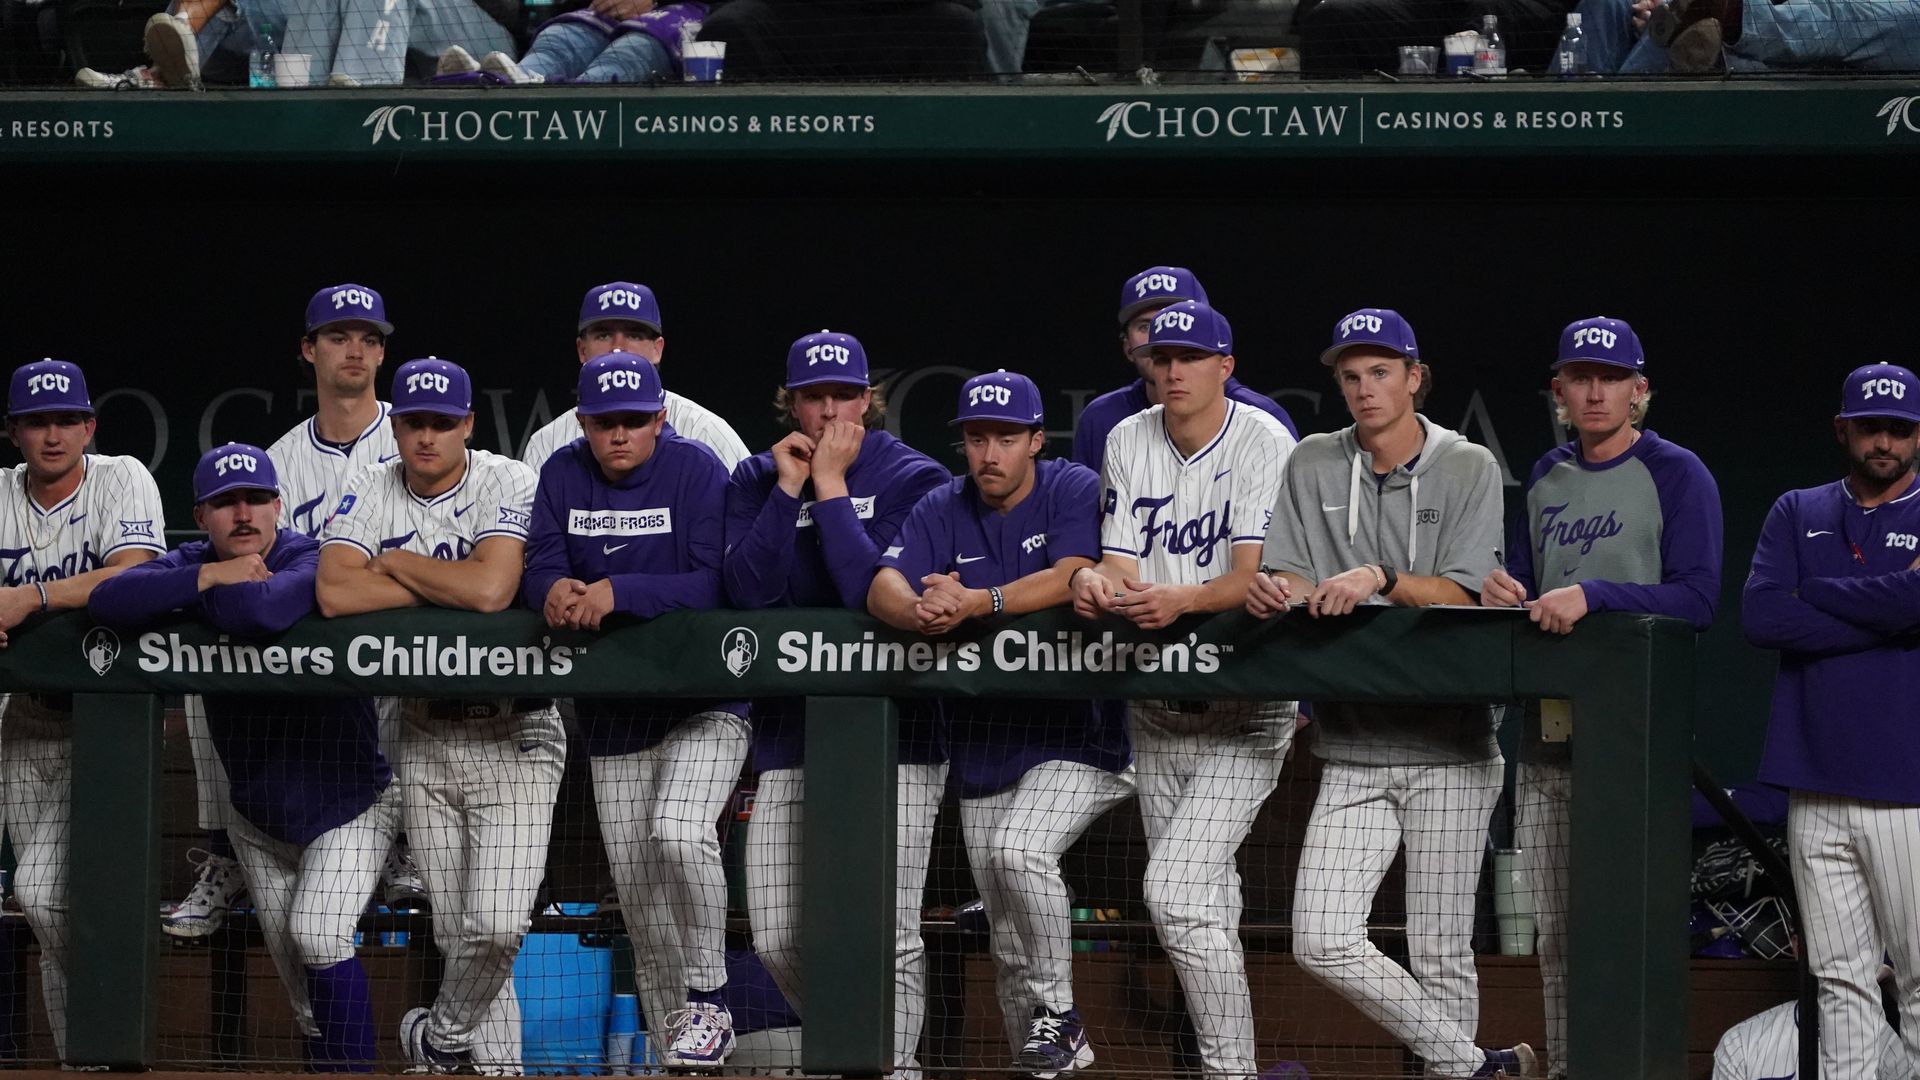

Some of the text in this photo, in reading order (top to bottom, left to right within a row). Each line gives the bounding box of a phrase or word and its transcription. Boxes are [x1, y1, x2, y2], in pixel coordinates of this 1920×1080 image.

[12, 120, 113, 138] RESORTS
[387, 104, 875, 141] CHOCTAW CASINOS & RESORTS
[1121, 101, 1624, 138] CHOCTAW CASINOS & RESORTS
[1135, 273, 1178, 298] TCU
[331, 288, 374, 310] TCU
[598, 288, 642, 311] TCU
[1154, 310, 1195, 334] TCU
[1340, 314, 1383, 339] TCU
[1573, 327, 1618, 349] TCU
[805, 344, 850, 367] TCU
[27, 373, 71, 395] TCU
[406, 372, 450, 394] TCU
[597, 370, 642, 393] TCU
[1861, 378, 1907, 400] TCU
[968, 384, 1012, 407] TCU
[214, 453, 257, 477] TCU
[573, 514, 665, 531] HONED FROGS
[1536, 502, 1624, 556] Frogs
[1885, 531, 1919, 551] TCU
[138, 632, 334, 675] Shriners
[776, 630, 981, 673] Shriners
